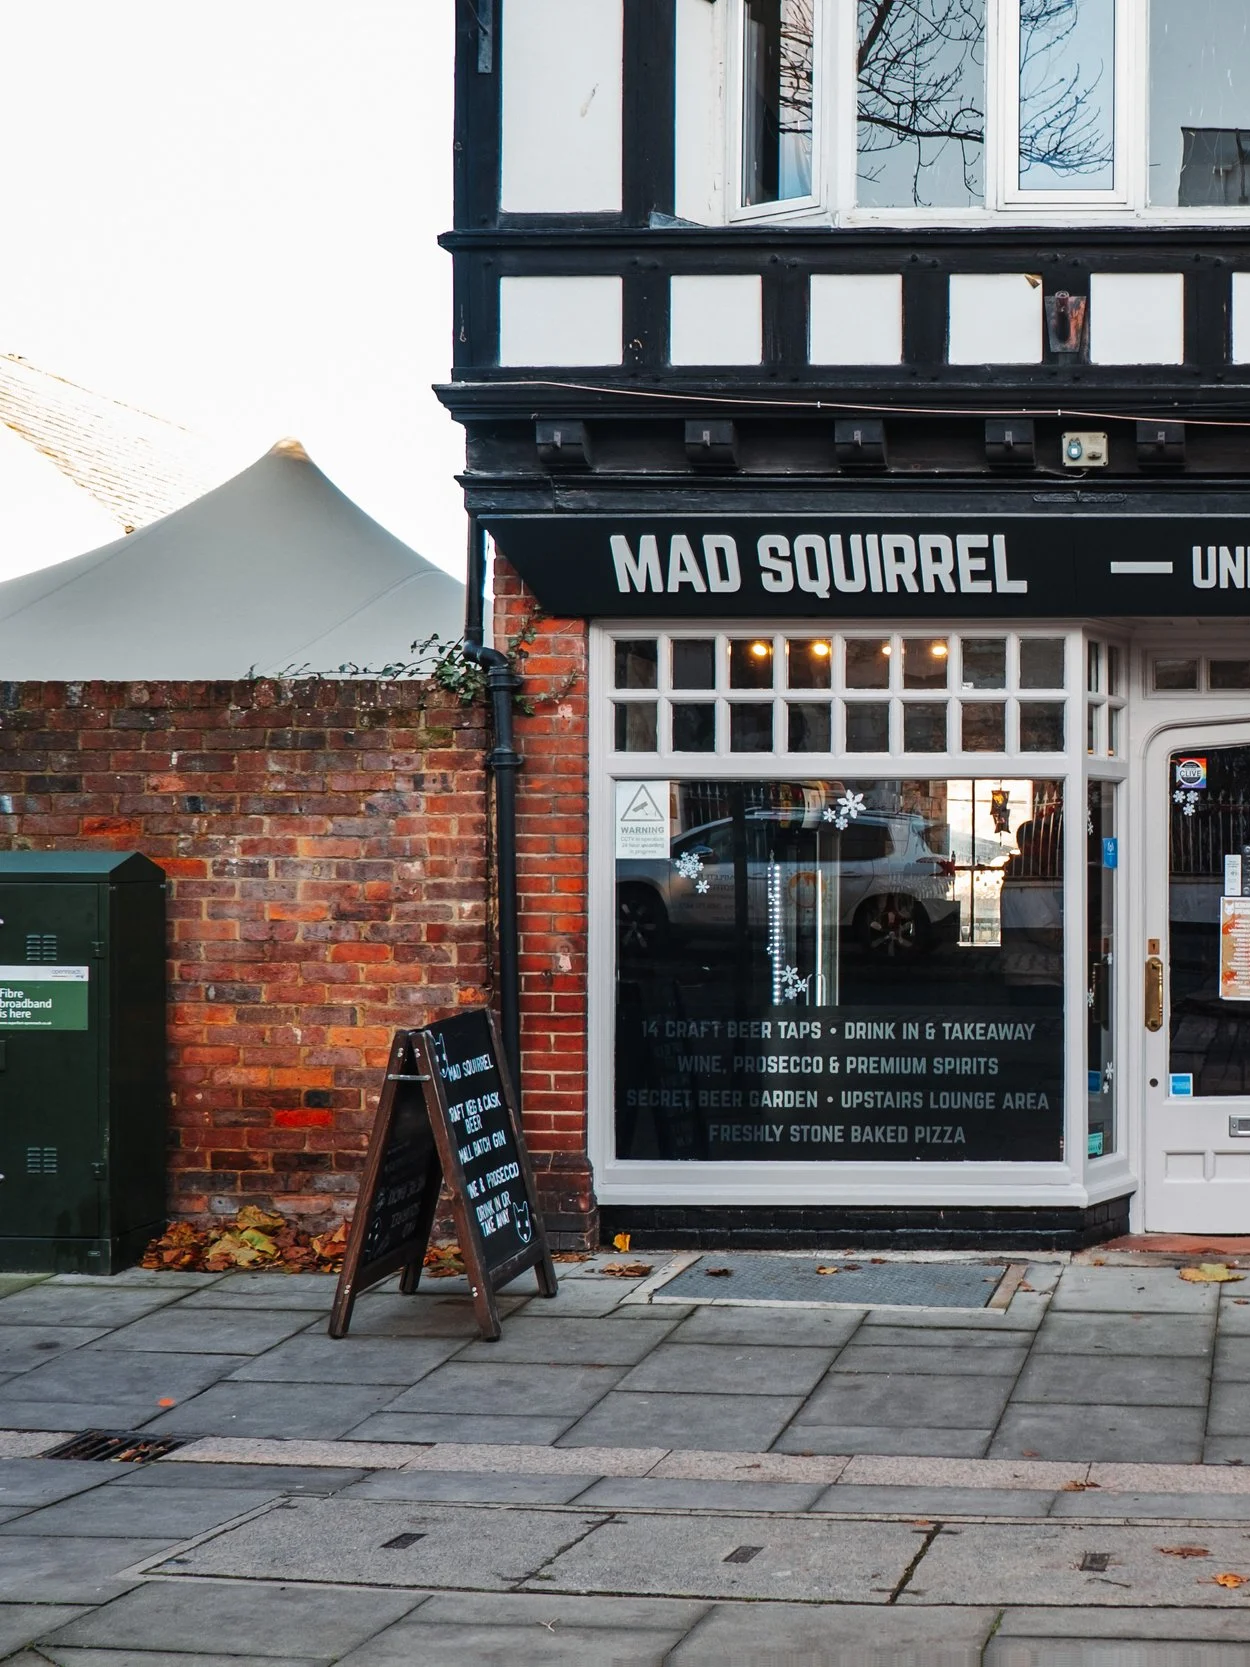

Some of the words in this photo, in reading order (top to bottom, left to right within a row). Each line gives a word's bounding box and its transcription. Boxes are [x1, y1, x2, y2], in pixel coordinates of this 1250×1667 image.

[610, 534, 741, 593] MAD
[756, 534, 1028, 598] SQUIRREL
[621, 826, 665, 834] WARNING
[0, 988, 24, 998] Fibre
[0, 998, 52, 1008] broadband
[9, 1009, 32, 1018] here
[665, 1020, 720, 1038] CRAFT
[727, 1021, 772, 1039] BEER
[778, 1021, 822, 1039] TAPS
[844, 1022, 896, 1040] DRINK
[902, 1022, 919, 1040] IN
[925, 1022, 936, 1040] &
[942, 1023, 1036, 1041] TAKEAWAY
[448, 1063, 461, 1082] MAD
[462, 1054, 494, 1077] SQUIRREL
[677, 1056, 728, 1074] WINE,
[733, 1055, 824, 1074] PROSECCO
[829, 1056, 840, 1074] &
[846, 1057, 927, 1075] PREMIUM
[933, 1057, 999, 1075] SPIRITS
[448, 1103, 465, 1123] RAFT
[465, 1099, 478, 1116] KEG
[482, 1091, 501, 1111] CASK
[626, 1089, 693, 1107] SECRET
[698, 1090, 743, 1108] BEER
[750, 1090, 818, 1108] GARDEN
[841, 1090, 923, 1109] UPSTAIRS
[929, 1091, 996, 1109] LOUNGE
[1002, 1092, 1050, 1110] AREA
[464, 1114, 483, 1135] BEER
[708, 1124, 784, 1142] FRESHLY
[790, 1125, 845, 1142] STONE
[850, 1125, 909, 1143] BAKED
[914, 1126, 966, 1144] PIZZA
[458, 1144, 474, 1165] MALL
[472, 1136, 492, 1157] BATCH
[492, 1130, 507, 1149] GIN
[485, 1162, 520, 1189] PROSECCO
[476, 1200, 496, 1222] DRINK
[500, 1191, 512, 1208] OR
[480, 1216, 497, 1238] TAKE
